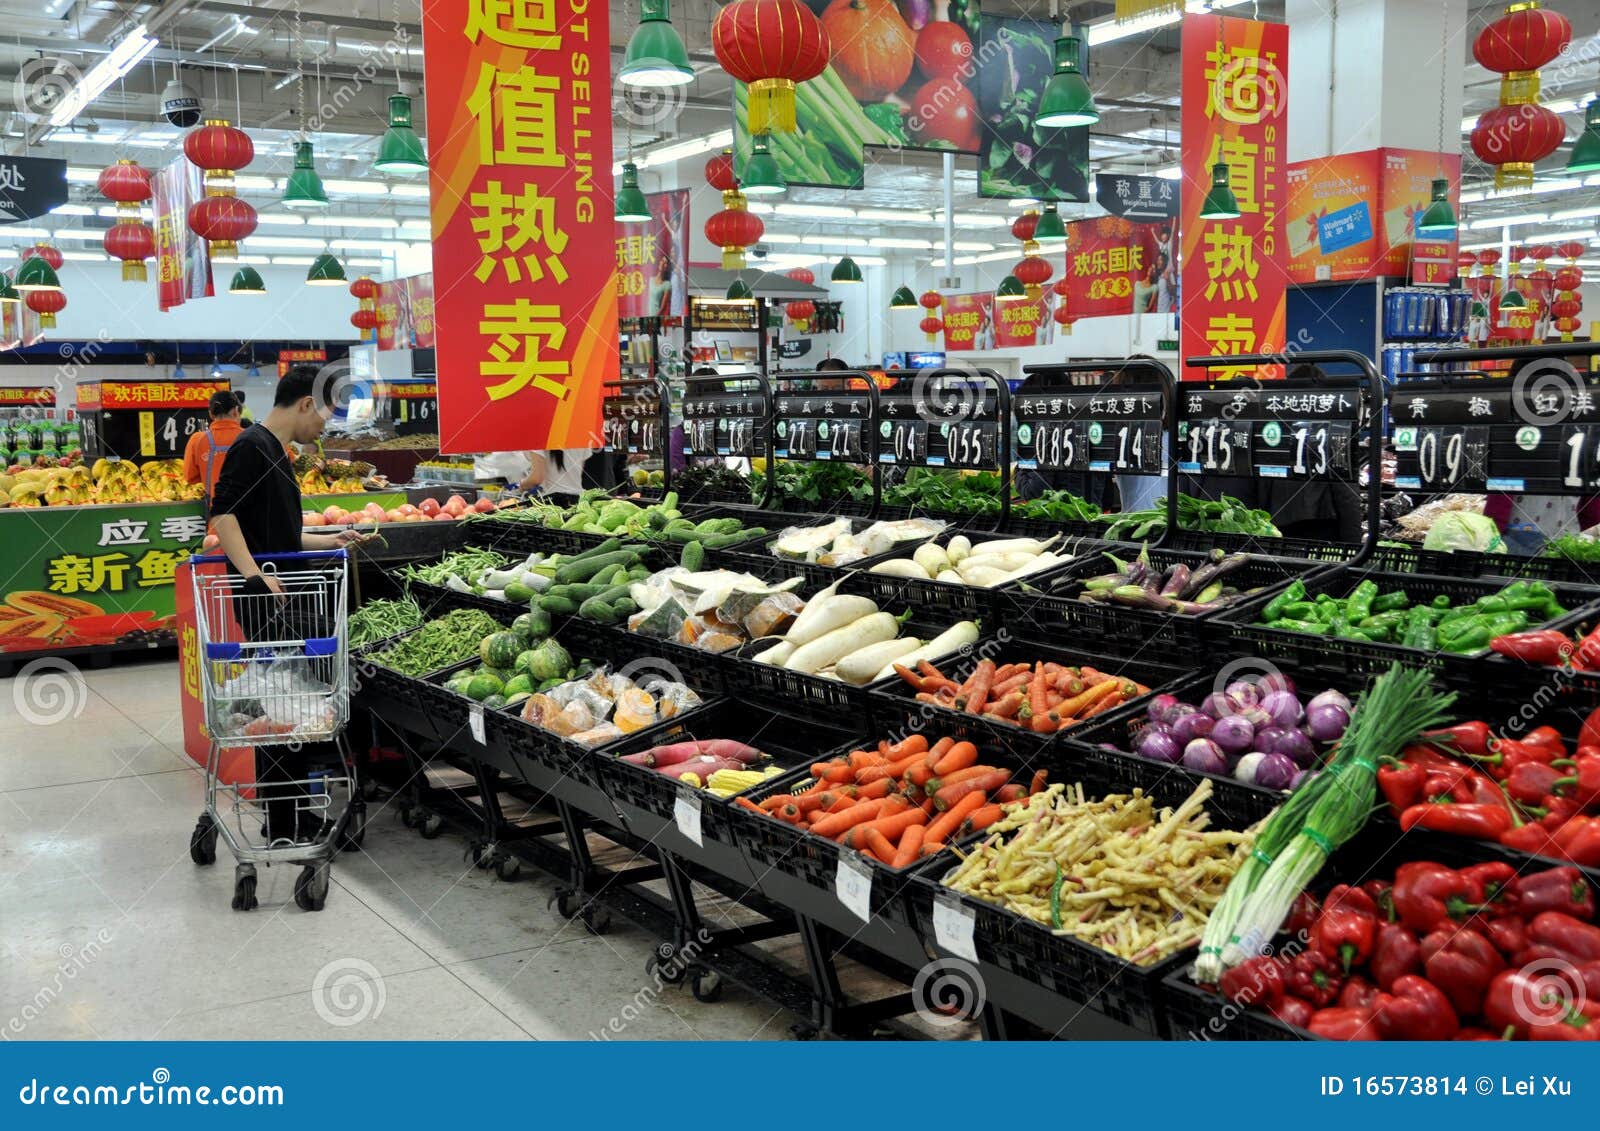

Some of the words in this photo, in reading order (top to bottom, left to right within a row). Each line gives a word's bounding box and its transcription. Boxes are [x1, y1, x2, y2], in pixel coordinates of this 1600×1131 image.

[1263, 51, 1277, 112] HOT
[571, 52, 593, 223] SELLING
[1115, 179, 1172, 200] 称重处
[1263, 125, 1276, 256] SELLING
[1323, 215, 1353, 231] Walmart
[1074, 244, 1144, 277] 欢乐国庆
[114, 385, 179, 402] 欢乐国庆
[1020, 399, 1076, 415] 长白萝卜
[1089, 397, 1152, 414] 红皮萝卜
[1188, 396, 1247, 413] 茄子
[1266, 394, 1351, 412] 本地胡萝卜
[1408, 396, 1492, 417] 青椒
[1036, 426, 1074, 467] 0.85
[1117, 427, 1142, 469] 1.4
[1419, 432, 1461, 485] 0.9
[97, 515, 206, 546] 应季
